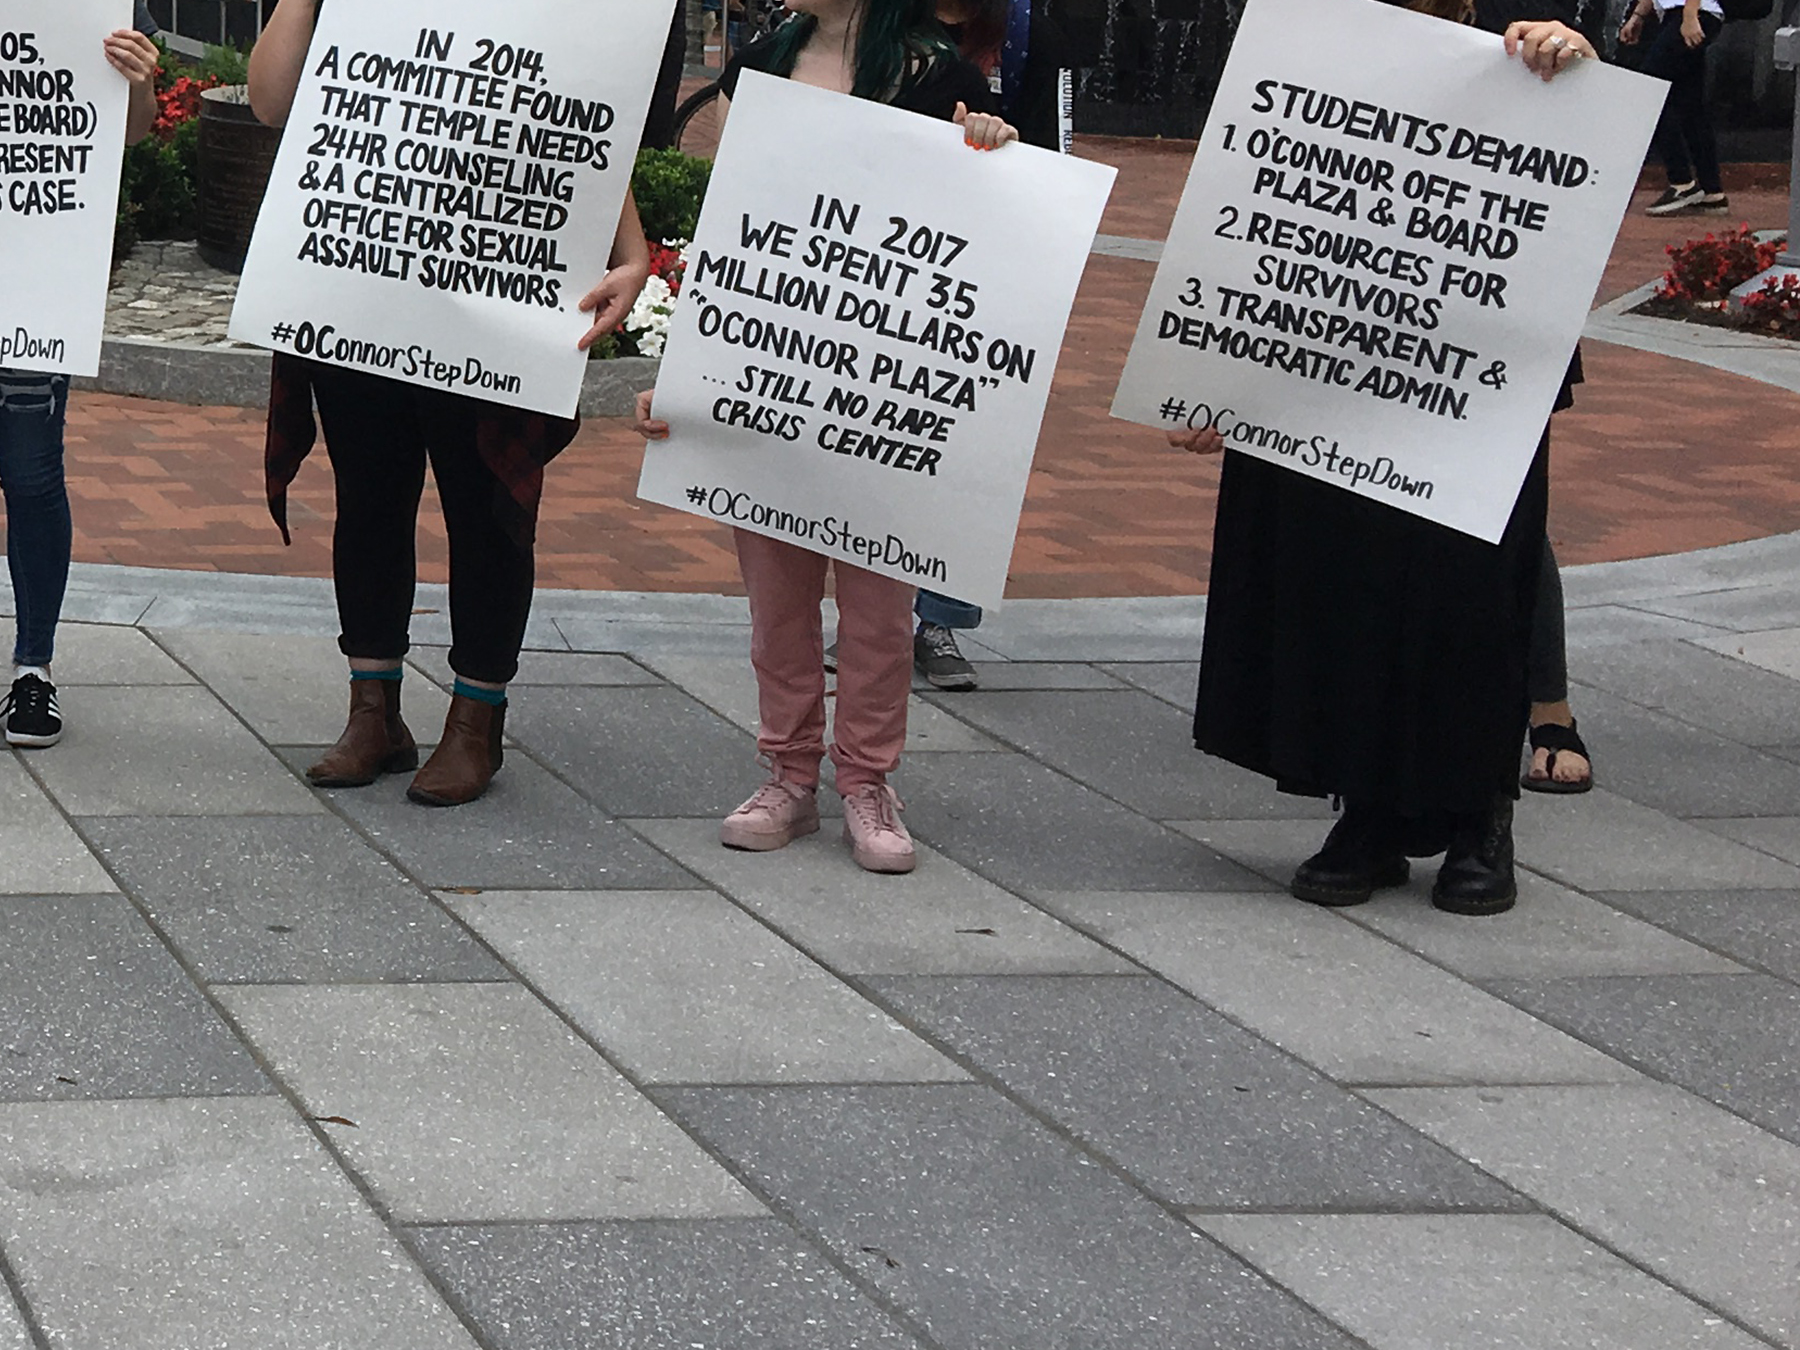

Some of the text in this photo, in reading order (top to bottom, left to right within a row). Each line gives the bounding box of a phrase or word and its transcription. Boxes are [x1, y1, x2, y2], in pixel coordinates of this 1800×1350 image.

[315, 45, 614, 133] A COMMITTEE FOUND
[415, 28, 547, 86] IN 2014,
[13, 101, 97, 140] BOARD)
[321, 85, 612, 170] THAT TEMPLE NEEDS
[1251, 80, 1599, 188] STUDENTS DEMAND:
[9, 179, 85, 216] CASE.
[298, 160, 568, 231] & A CENTRALIZED
[395, 139, 574, 203] COUNSELING
[1247, 127, 1394, 193] O'CONNOR
[1403, 170, 1471, 210] OFF
[1480, 190, 1549, 232] THE
[303, 198, 567, 272] OFFICE FOR SEXUAL
[810, 194, 969, 268] IN 2017
[1253, 167, 1518, 260] PLAZA & BOARD
[297, 232, 564, 312] ASSAULT SURVIVORS.
[741, 213, 798, 258] WE
[802, 235, 919, 297] SPENT
[1246, 212, 1434, 287] RESOURCES
[1440, 263, 1507, 309] FOR
[1253, 255, 1443, 330] SURVIVORS
[694, 250, 1036, 384] MILLION DOLLARS ON
[1217, 286, 1478, 380] TRANSPARENT
[1478, 360, 1508, 390] &
[735, 365, 814, 408] STILL
[823, 386, 868, 419] NO
[871, 399, 955, 442] RAPE
[1158, 310, 1469, 420] DEMOCRATIC ADMIN.
[712, 397, 942, 476] CRISIS CENTER
